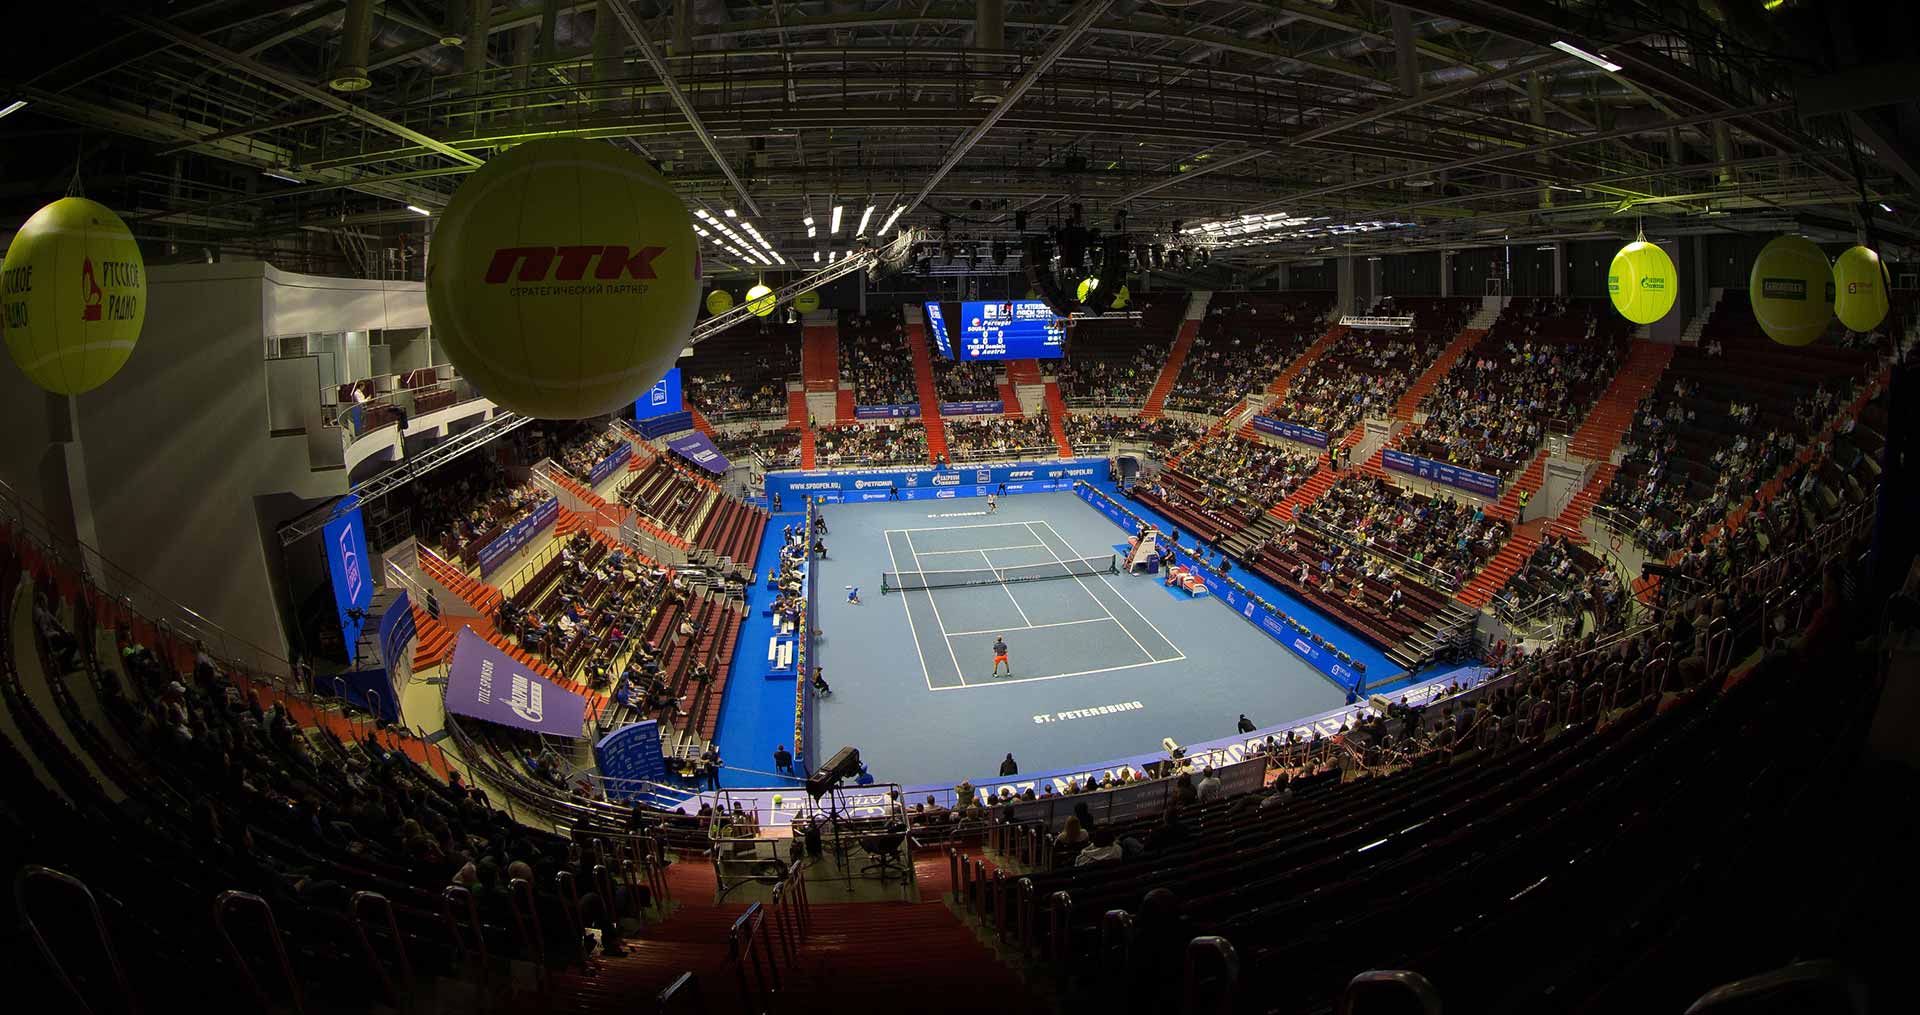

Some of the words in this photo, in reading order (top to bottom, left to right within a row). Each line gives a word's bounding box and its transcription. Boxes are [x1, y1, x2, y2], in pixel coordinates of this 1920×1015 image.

[485, 246, 666, 284] ПТК
[510, 284, 604, 297] СТРАТЕГИЧЕСКИЙ
[606, 284, 648, 295] ПАРТНЕР
[1033, 714, 1056, 723] ST.
[1057, 701, 1144, 720] PETERSBURG
